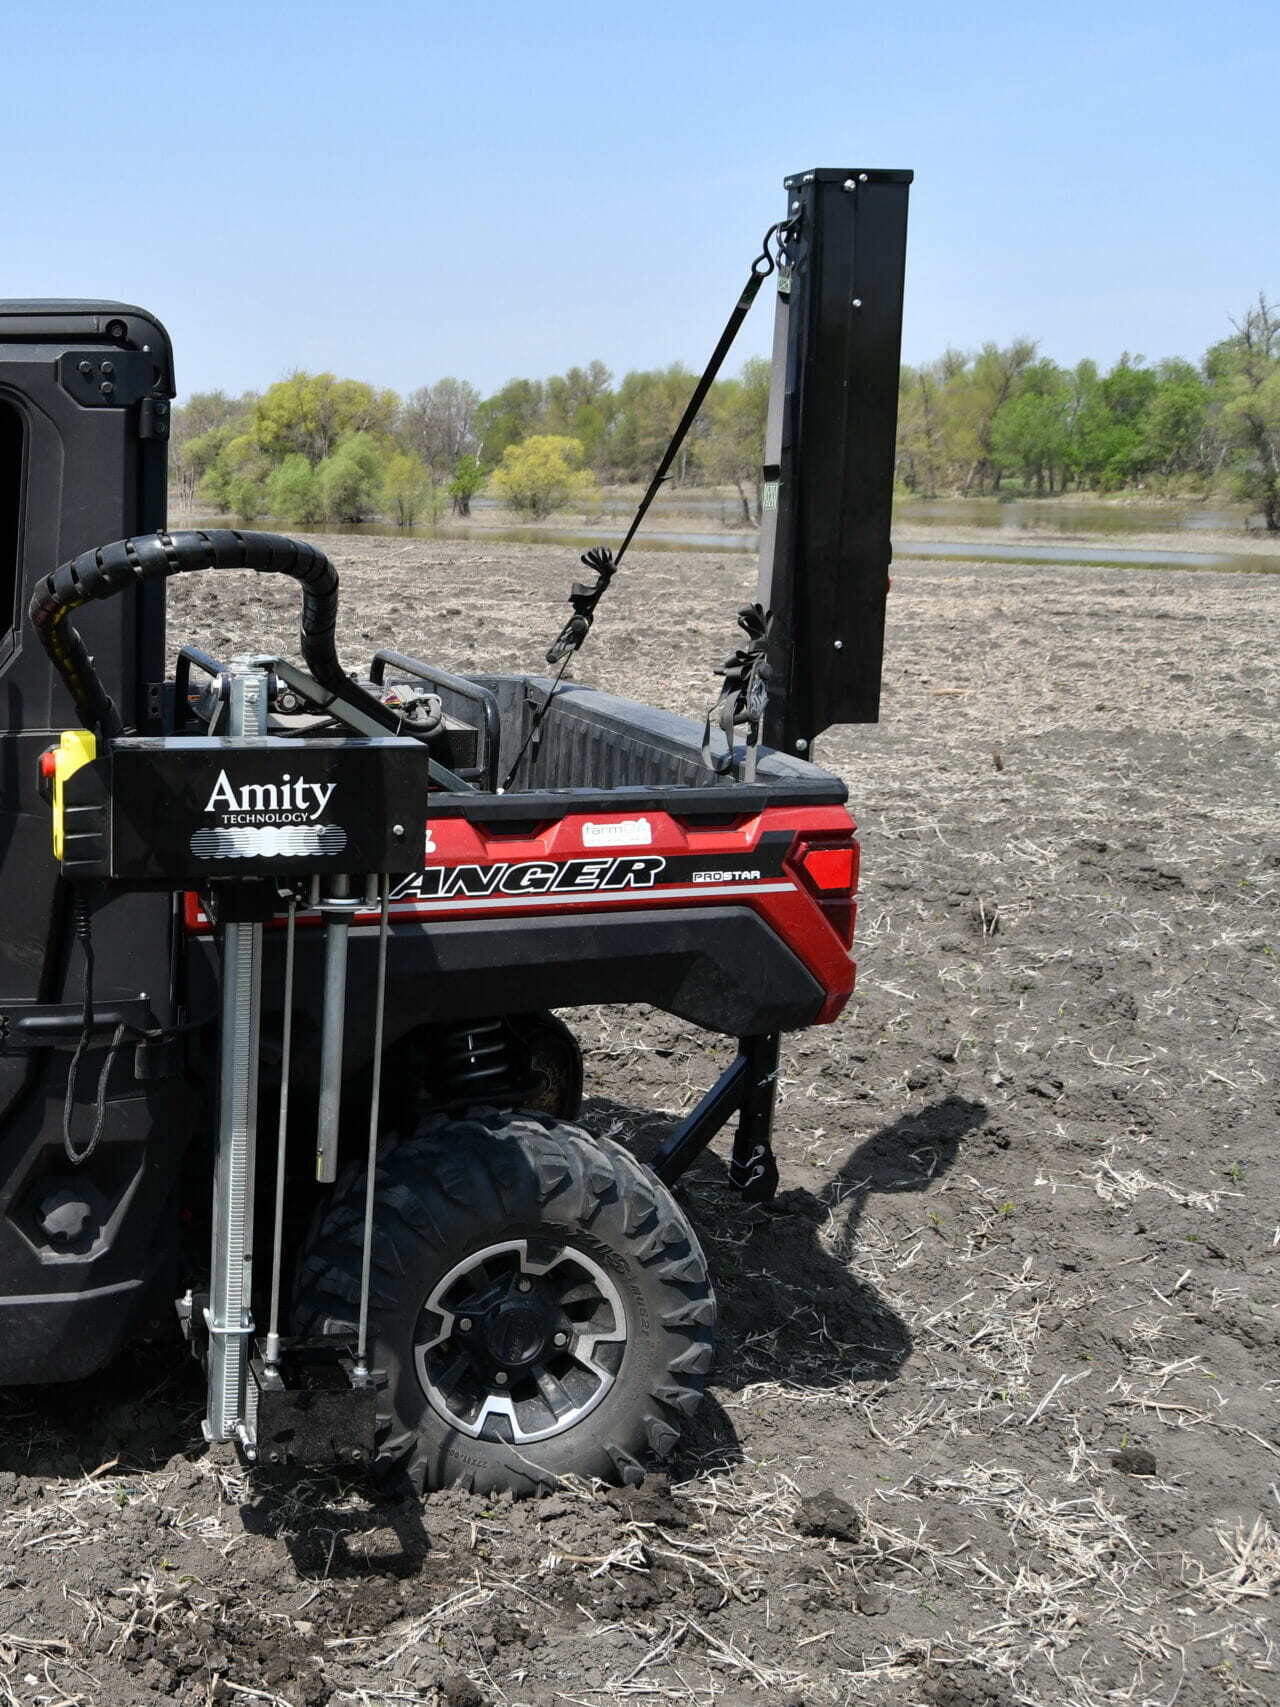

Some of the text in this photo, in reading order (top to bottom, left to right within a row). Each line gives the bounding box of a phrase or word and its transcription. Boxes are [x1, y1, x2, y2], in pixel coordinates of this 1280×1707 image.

[204, 769, 337, 820] Amity
[222, 812, 310, 825] TECHNOLOGY
[388, 855, 666, 900] ANGER
[693, 870, 761, 883] PROSTAR
